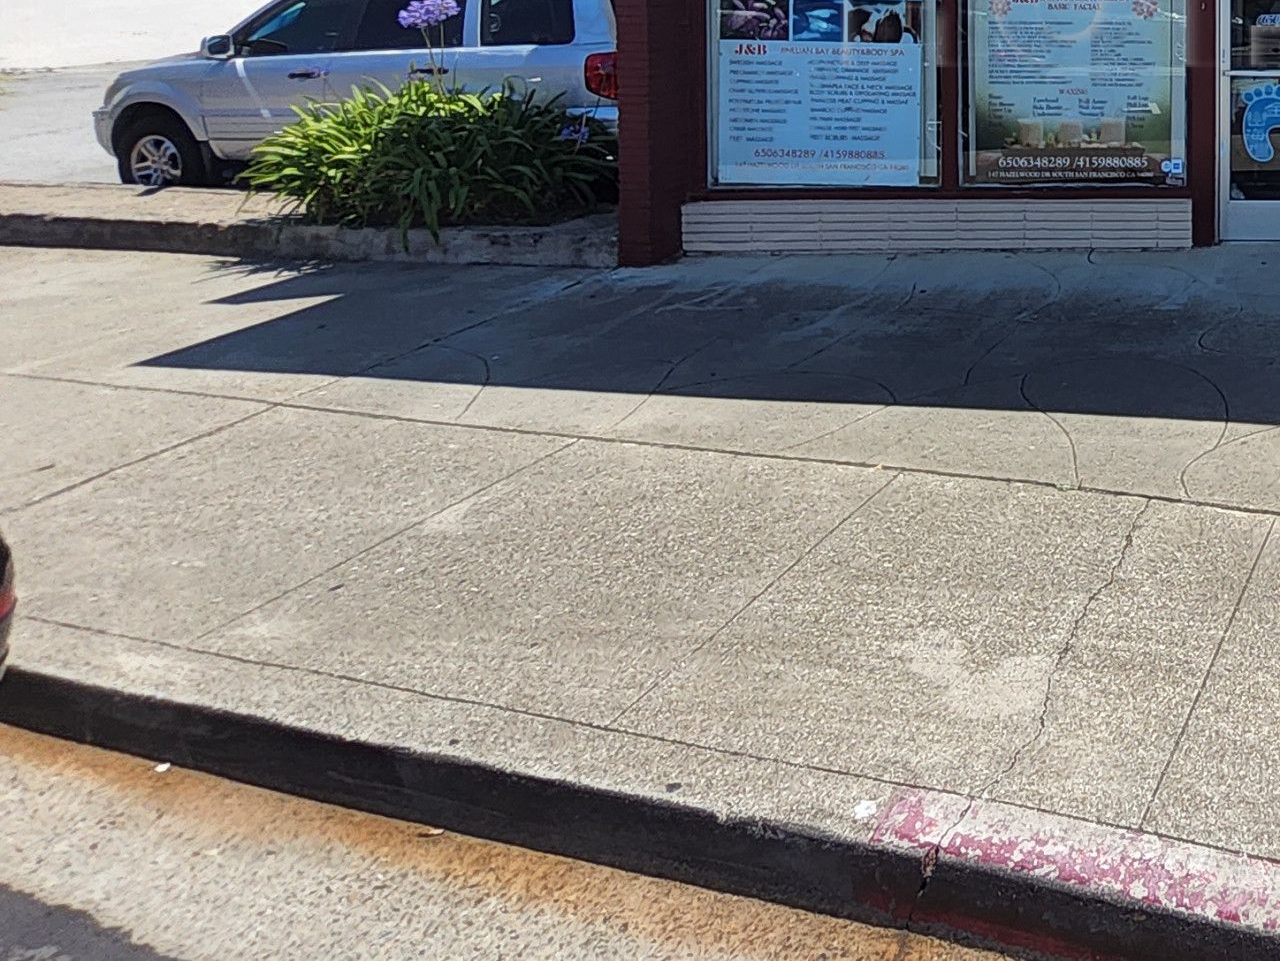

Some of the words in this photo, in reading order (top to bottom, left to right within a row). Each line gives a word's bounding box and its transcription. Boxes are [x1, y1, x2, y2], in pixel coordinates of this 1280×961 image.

[735, 43, 767, 56] J&B
[815, 47, 829, 55] BAY
[890, 48, 905, 56] SPA
[754, 149, 816, 159] 6506348289
[998, 156, 1070, 168] 6506348289
[1073, 156, 1148, 168] /4159880885
